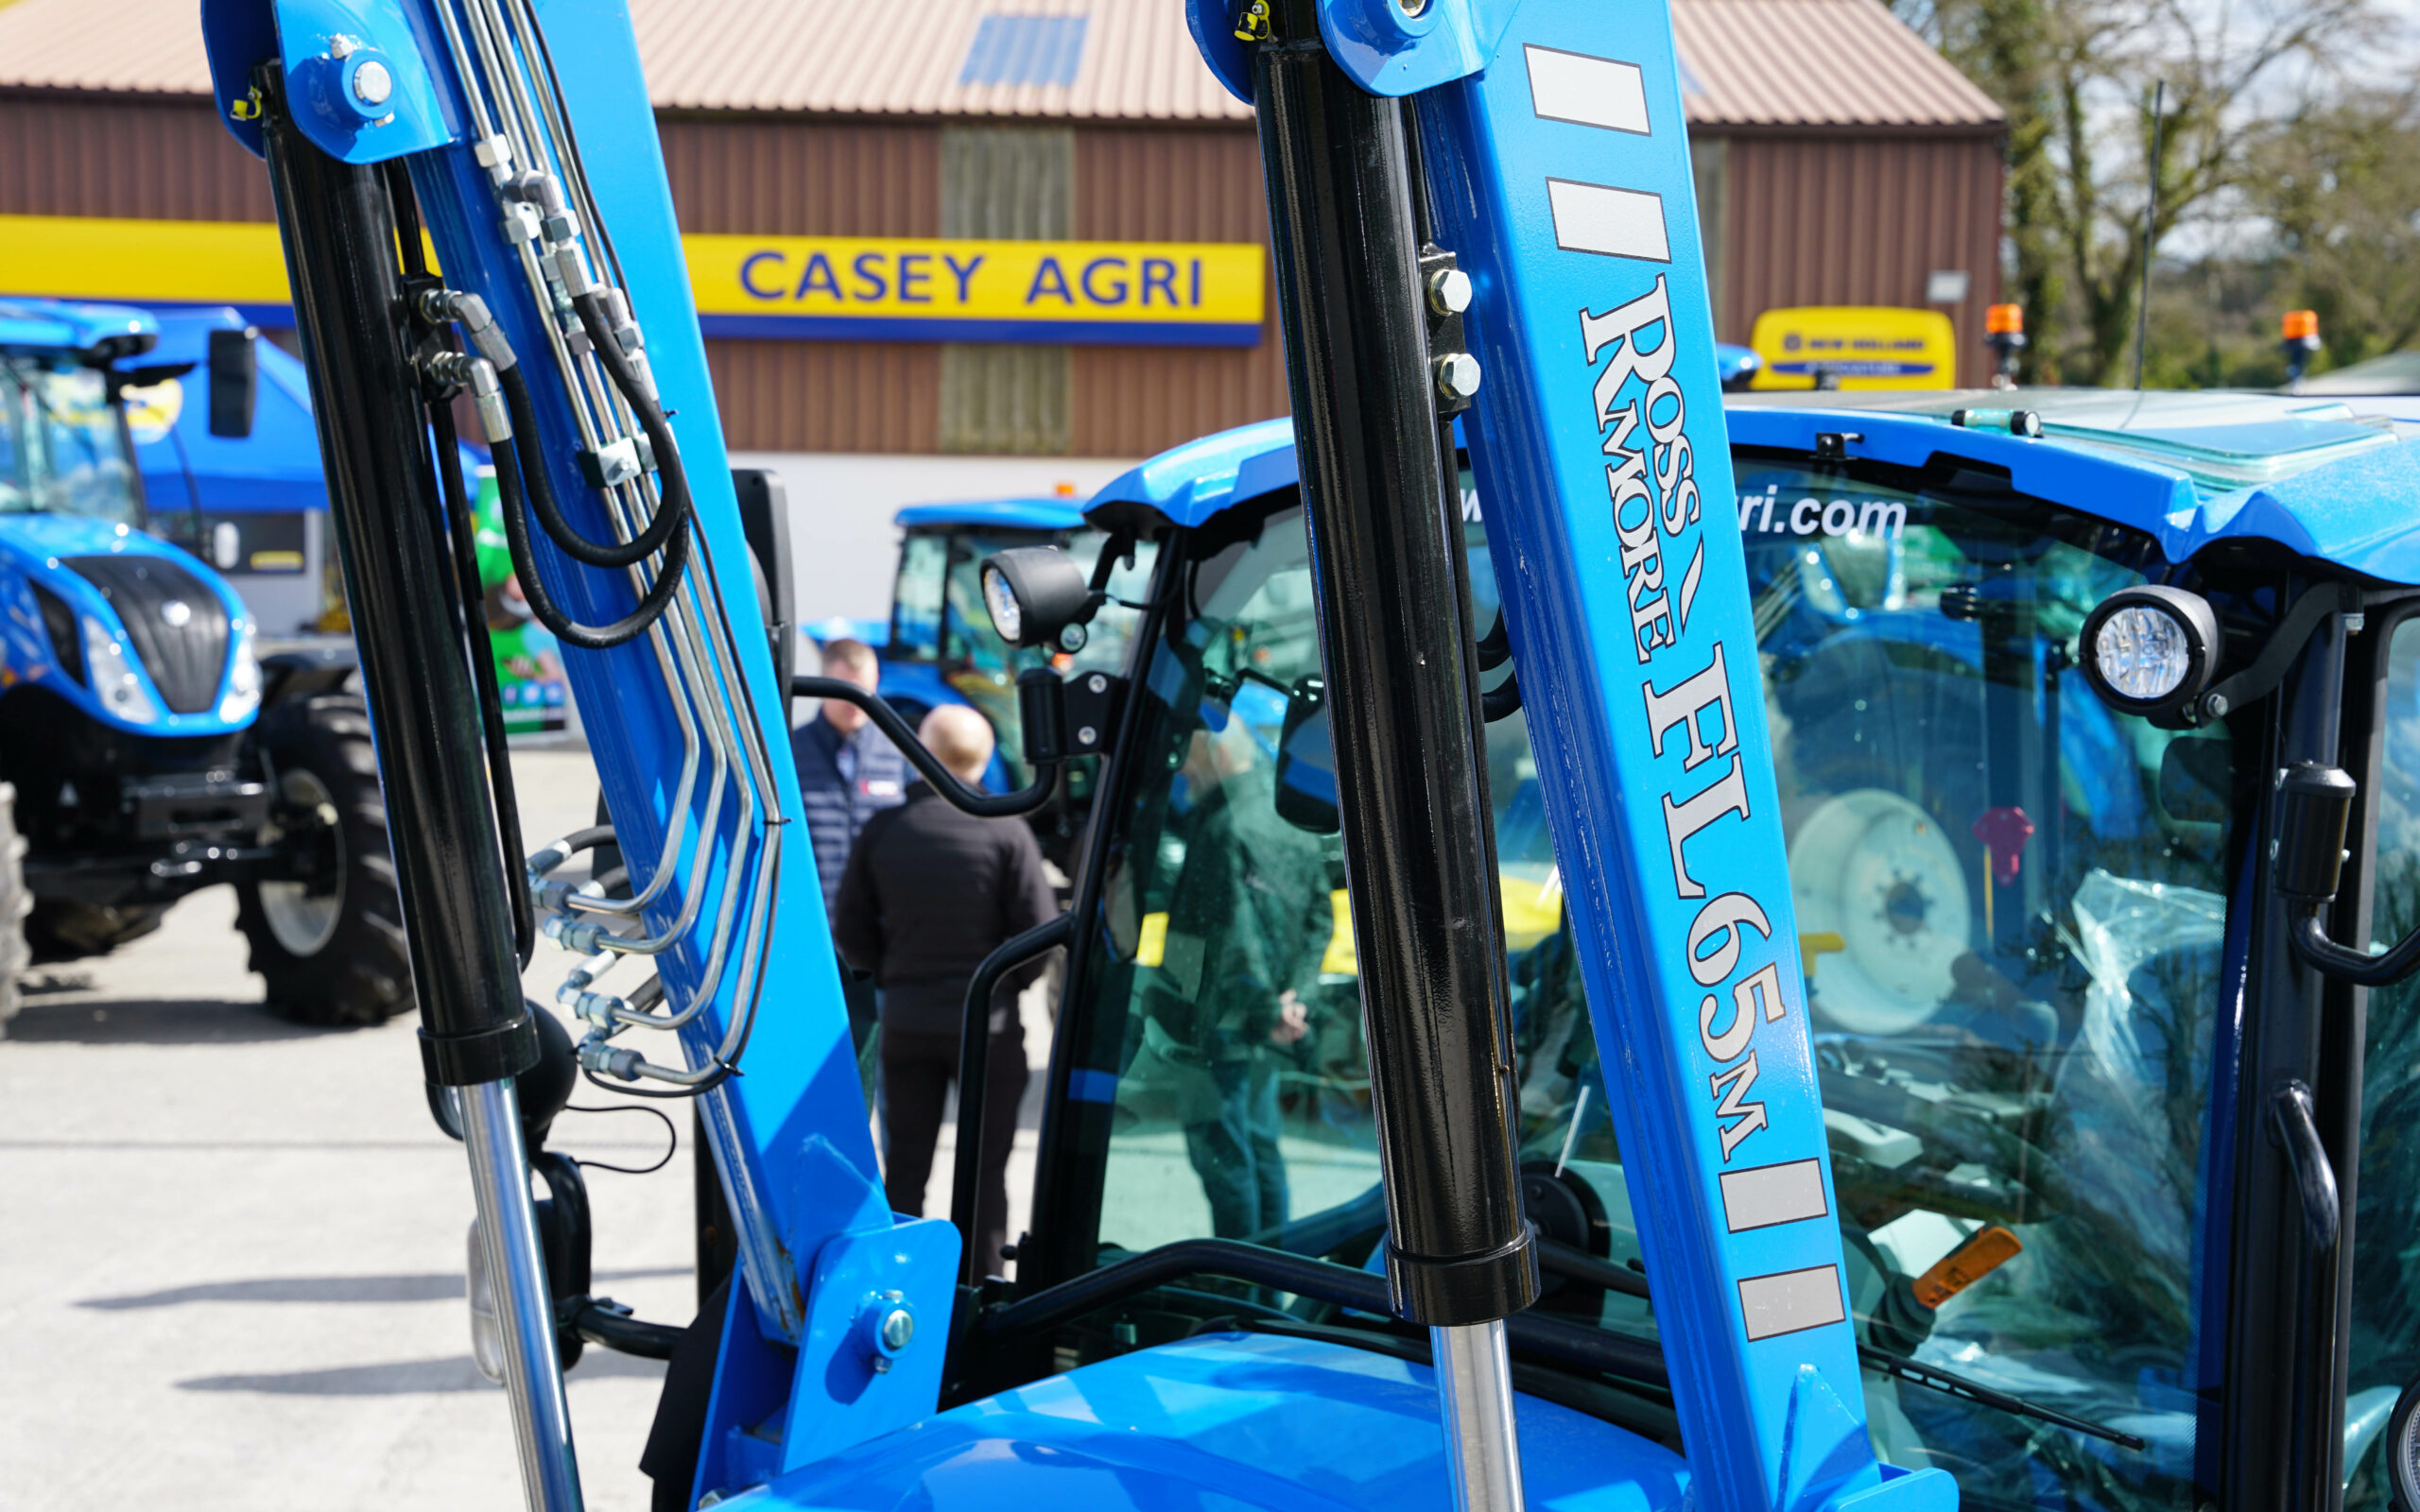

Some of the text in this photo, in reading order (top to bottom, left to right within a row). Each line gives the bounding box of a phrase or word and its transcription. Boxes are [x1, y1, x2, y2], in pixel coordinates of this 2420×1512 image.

[739, 249, 1202, 308] CASEY AGRI
[1737, 484, 1908, 540] ri.com
